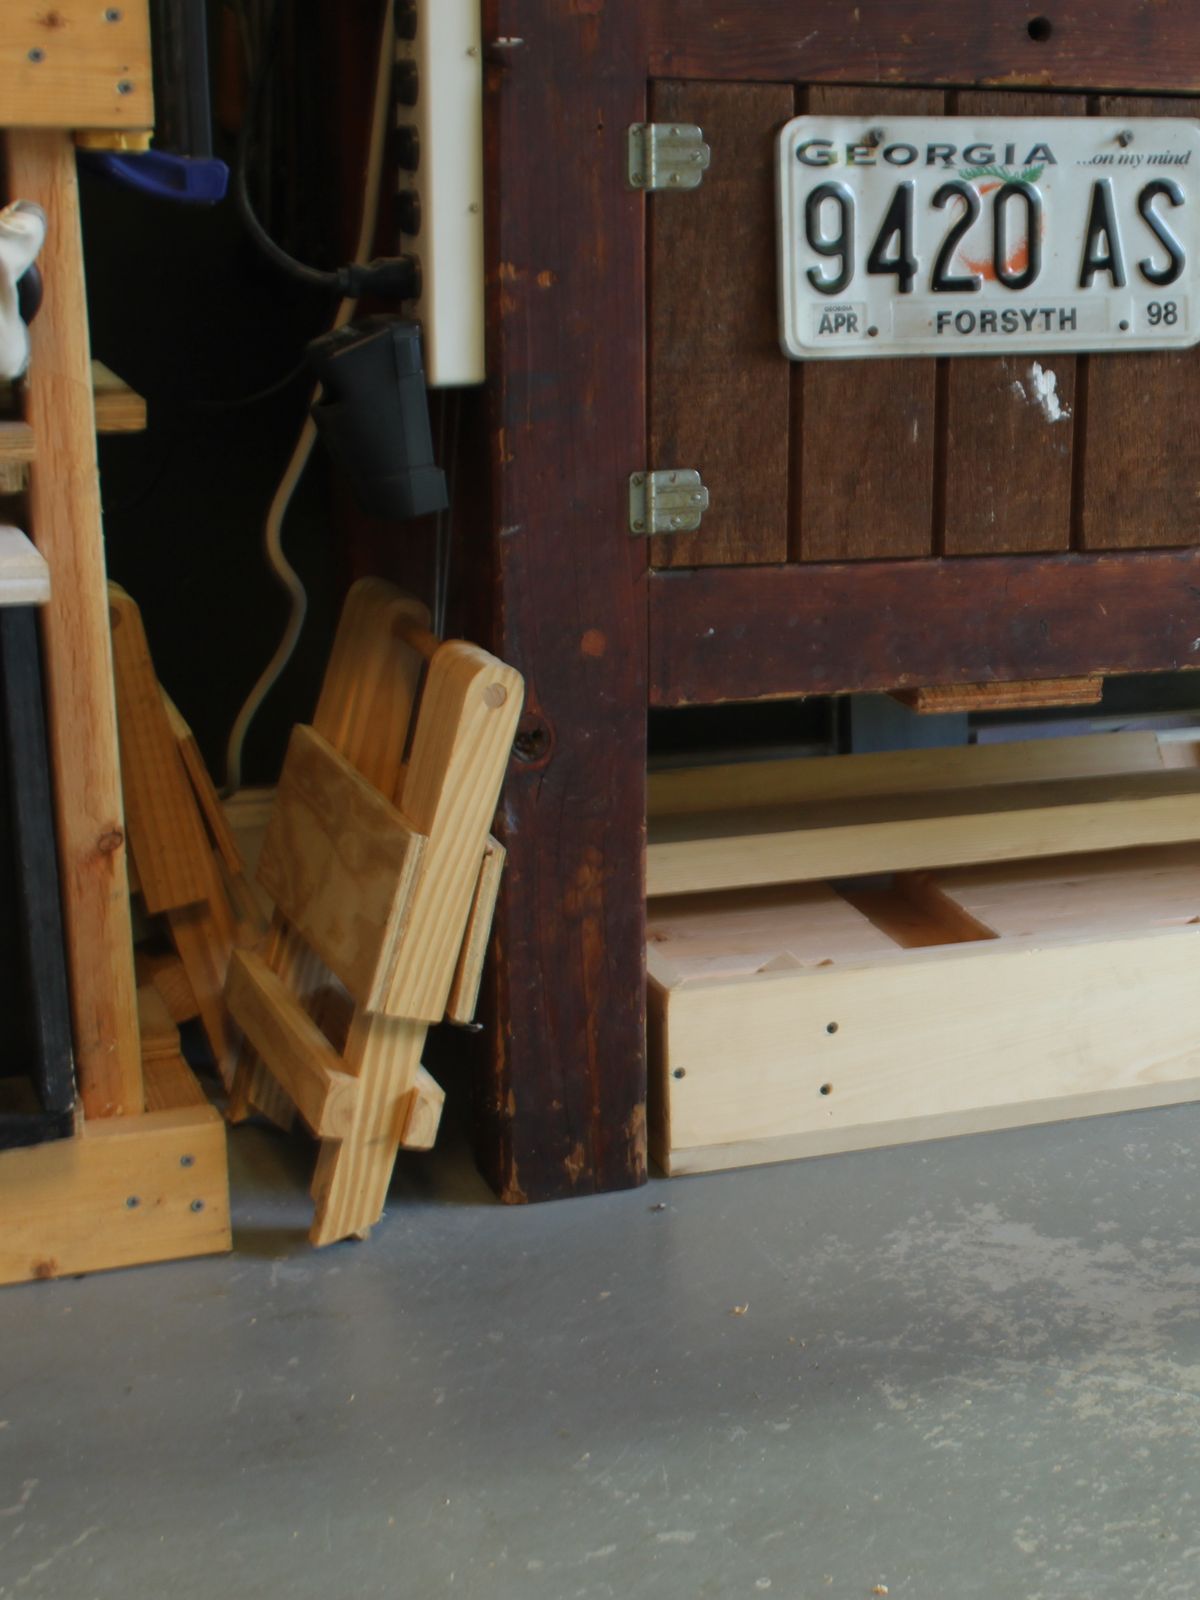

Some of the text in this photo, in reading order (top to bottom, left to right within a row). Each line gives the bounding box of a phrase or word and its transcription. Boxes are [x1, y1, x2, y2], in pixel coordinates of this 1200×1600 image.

[796, 139, 1057, 168] GEORGIA
[1118, 153, 1144, 168] my
[1146, 150, 1192, 165] mind
[805, 177, 1187, 295] 9420 AS
[818, 313, 859, 335] APR
[936, 308, 1078, 334] FORSYTH
[1147, 301, 1178, 326] 98
